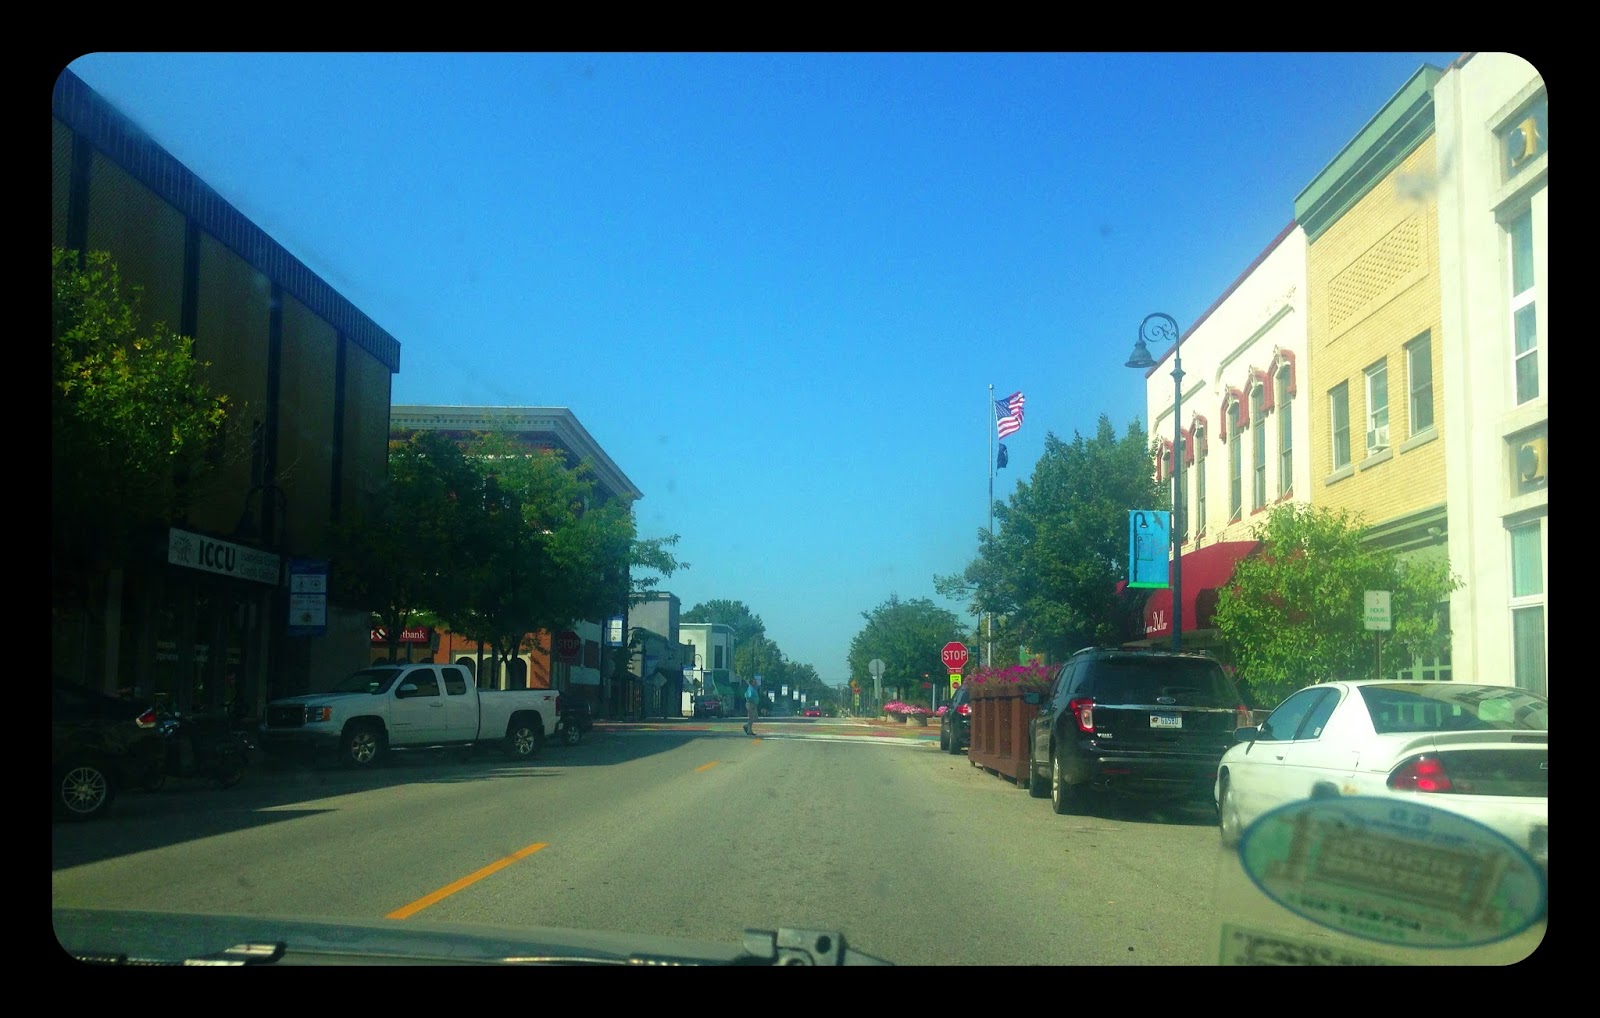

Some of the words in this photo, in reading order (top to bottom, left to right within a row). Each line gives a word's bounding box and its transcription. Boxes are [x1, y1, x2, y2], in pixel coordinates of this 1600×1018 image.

[198, 540, 236, 572] ICCU
[557, 639, 580, 649] STOP
[943, 650, 967, 661] STOP
